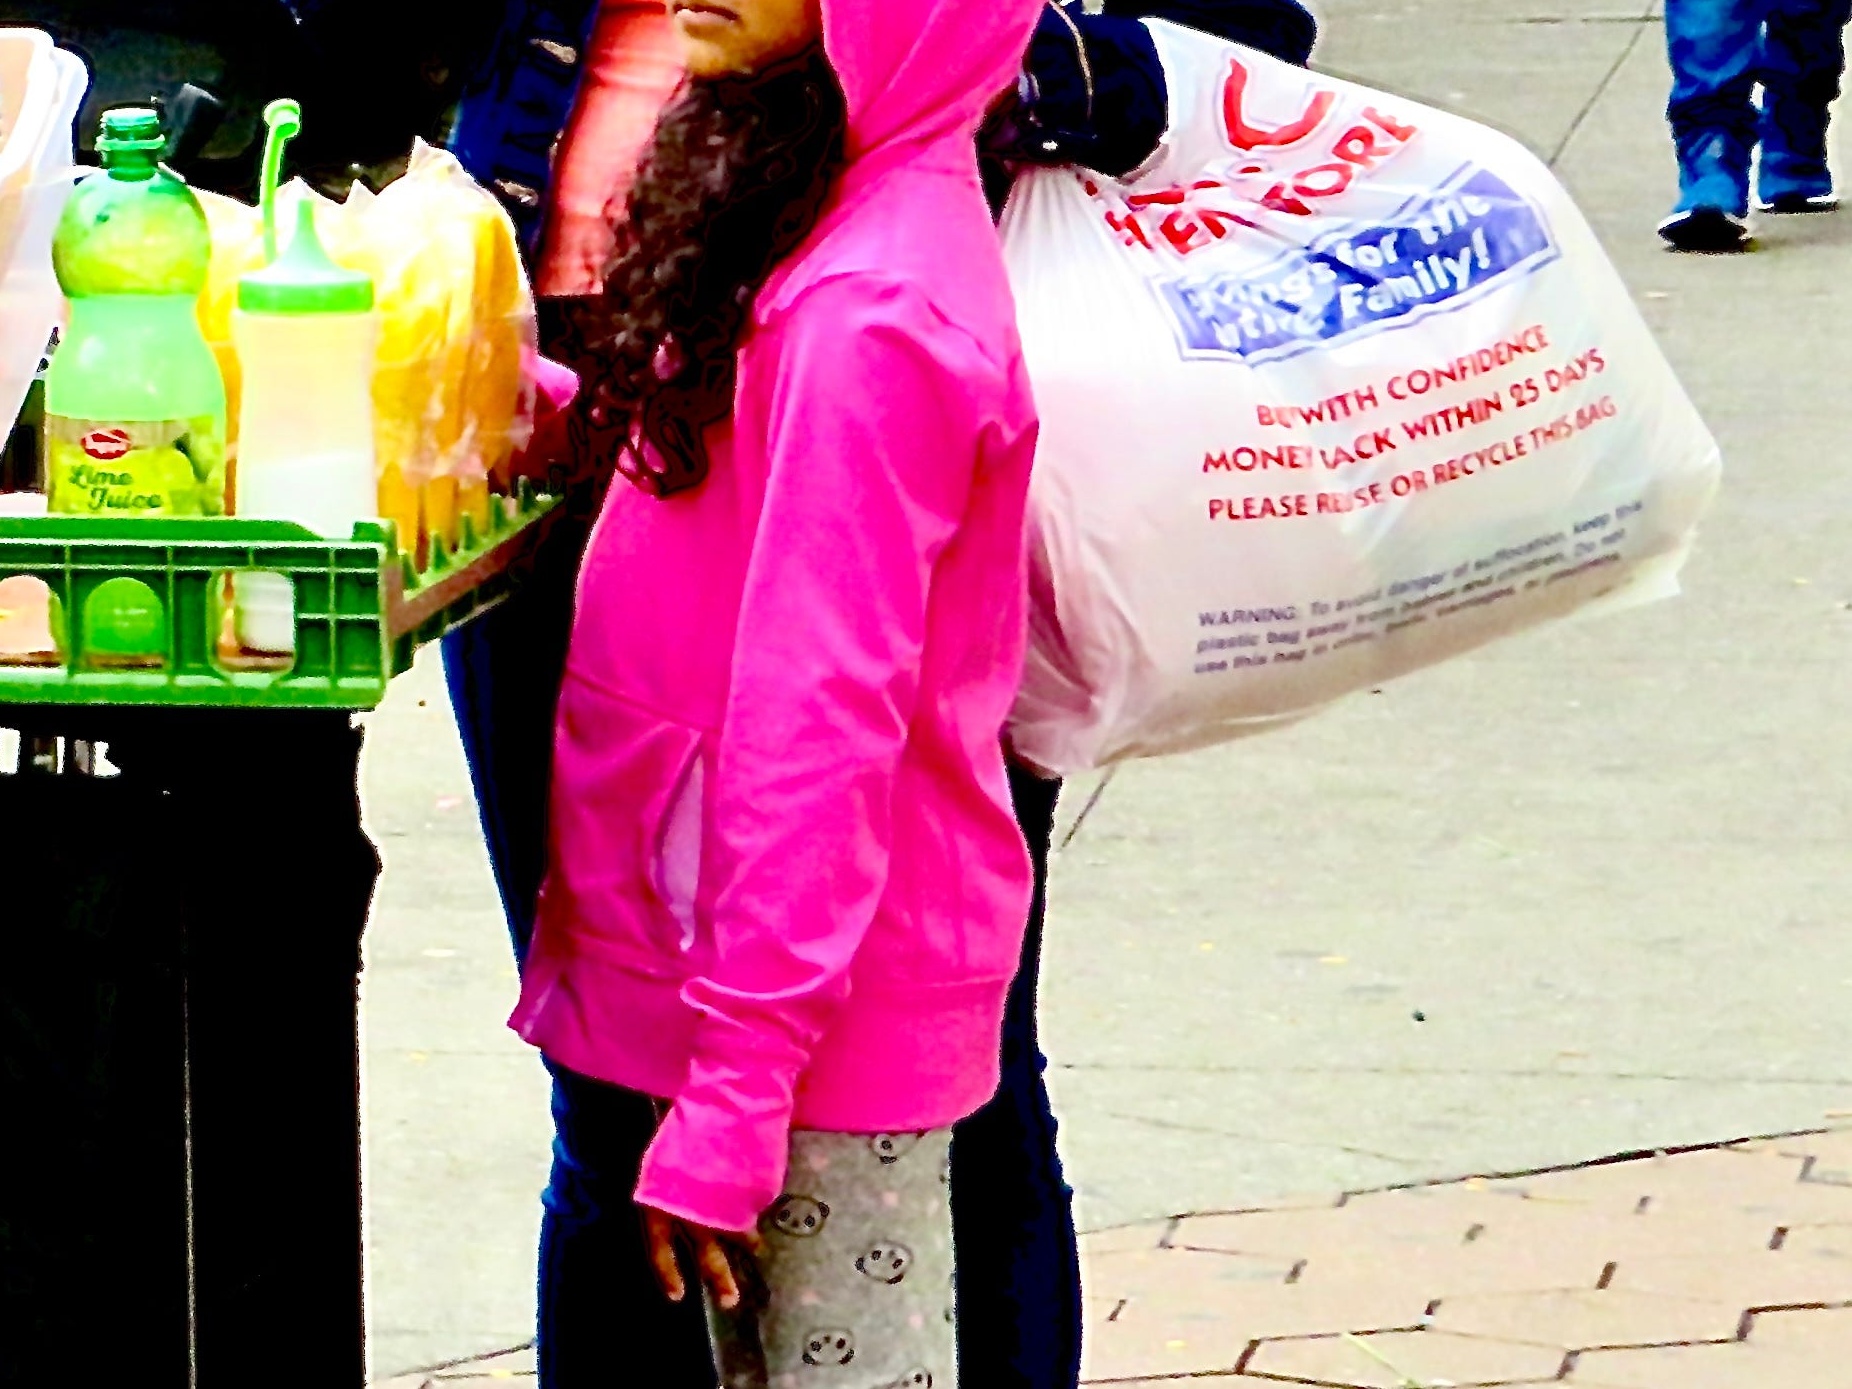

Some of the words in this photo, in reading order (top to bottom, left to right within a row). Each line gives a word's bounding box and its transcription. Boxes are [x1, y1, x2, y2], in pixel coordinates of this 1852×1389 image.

[1337, 231, 1399, 268] for
[1340, 227, 1491, 323] Family!
[1299, 385, 1378, 426] WITH
[1387, 324, 1549, 400] CONFIDENCE
[1319, 428, 1396, 469] ACK
[1401, 392, 1503, 440] WITHIN
[1544, 348, 1605, 392] DAYS
[69, 464, 133, 489] Lime
[88, 487, 163, 511] Juice
[1209, 494, 1308, 520] PLEASE
[1391, 470, 1428, 497] OR
[1432, 435, 1527, 484] RECYCLE
